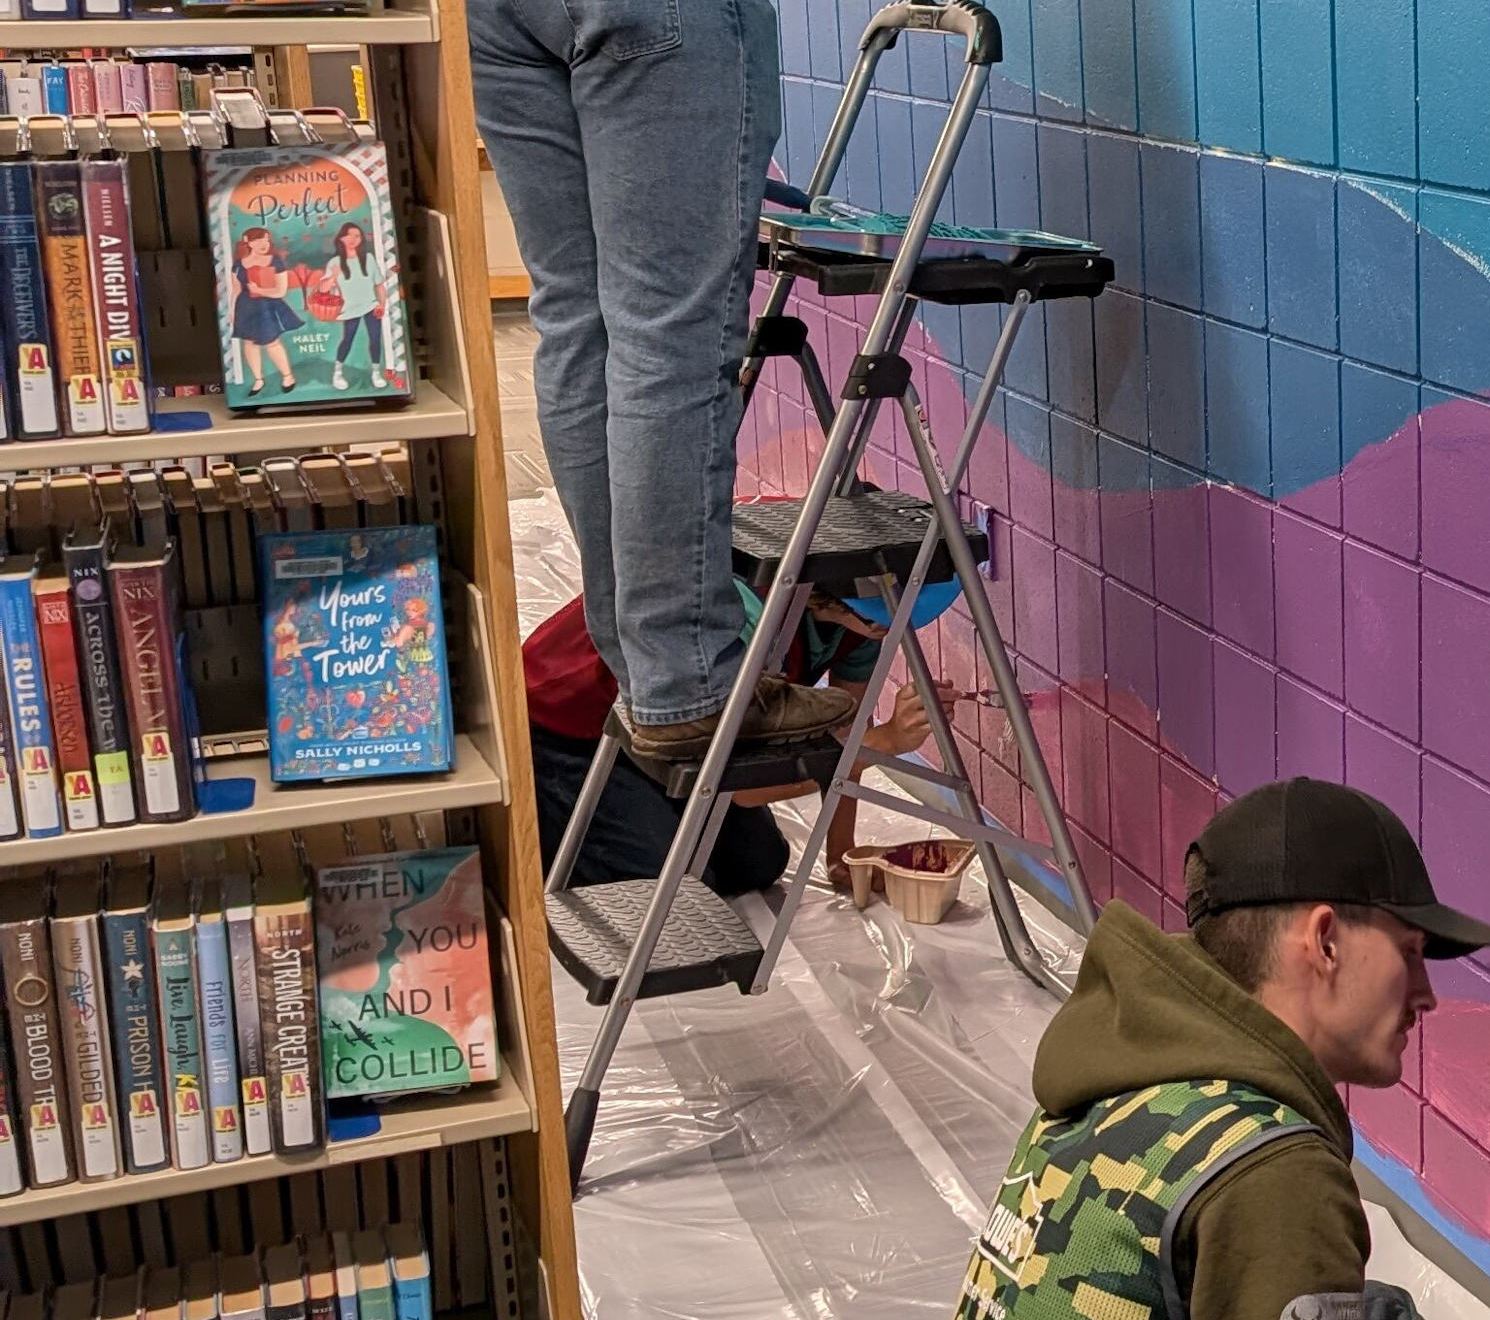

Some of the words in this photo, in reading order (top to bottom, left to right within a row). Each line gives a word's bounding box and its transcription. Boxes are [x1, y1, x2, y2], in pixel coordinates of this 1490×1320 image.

[254, 170, 339, 186] PLANNING
[248, 185, 350, 226] Perfect
[99, 234, 121, 247] A
[61, 244, 82, 302] MARK
[100, 249, 128, 308] NIGHT
[68, 325, 91, 375] THIEF
[299, 344, 326, 353] NEIL
[73, 568, 99, 577] NIX
[124, 587, 155, 599] NIX
[320, 580, 386, 627] Yours
[341, 611, 382, 631] from
[132, 614, 162, 704] ANGEL
[312, 648, 391, 682] Tower
[340, 633, 371, 656] the
[13, 657, 41, 732] RULES
[295, 746, 343, 759] SALLY
[346, 741, 421, 756] NICHOLLS
[322, 868, 424, 903] WHEN
[408, 923, 478, 954] YOU
[206, 981, 225, 1028] Friends
[272, 947, 306, 1023] STRANGE
[359, 988, 432, 1021] AND
[445, 985, 452, 1011] I
[25, 1024, 53, 1080] BLOOD
[128, 1016, 153, 1077] PRISON
[335, 1042, 486, 1084] COLLIDE
[77, 1042, 103, 1103] GILDED
